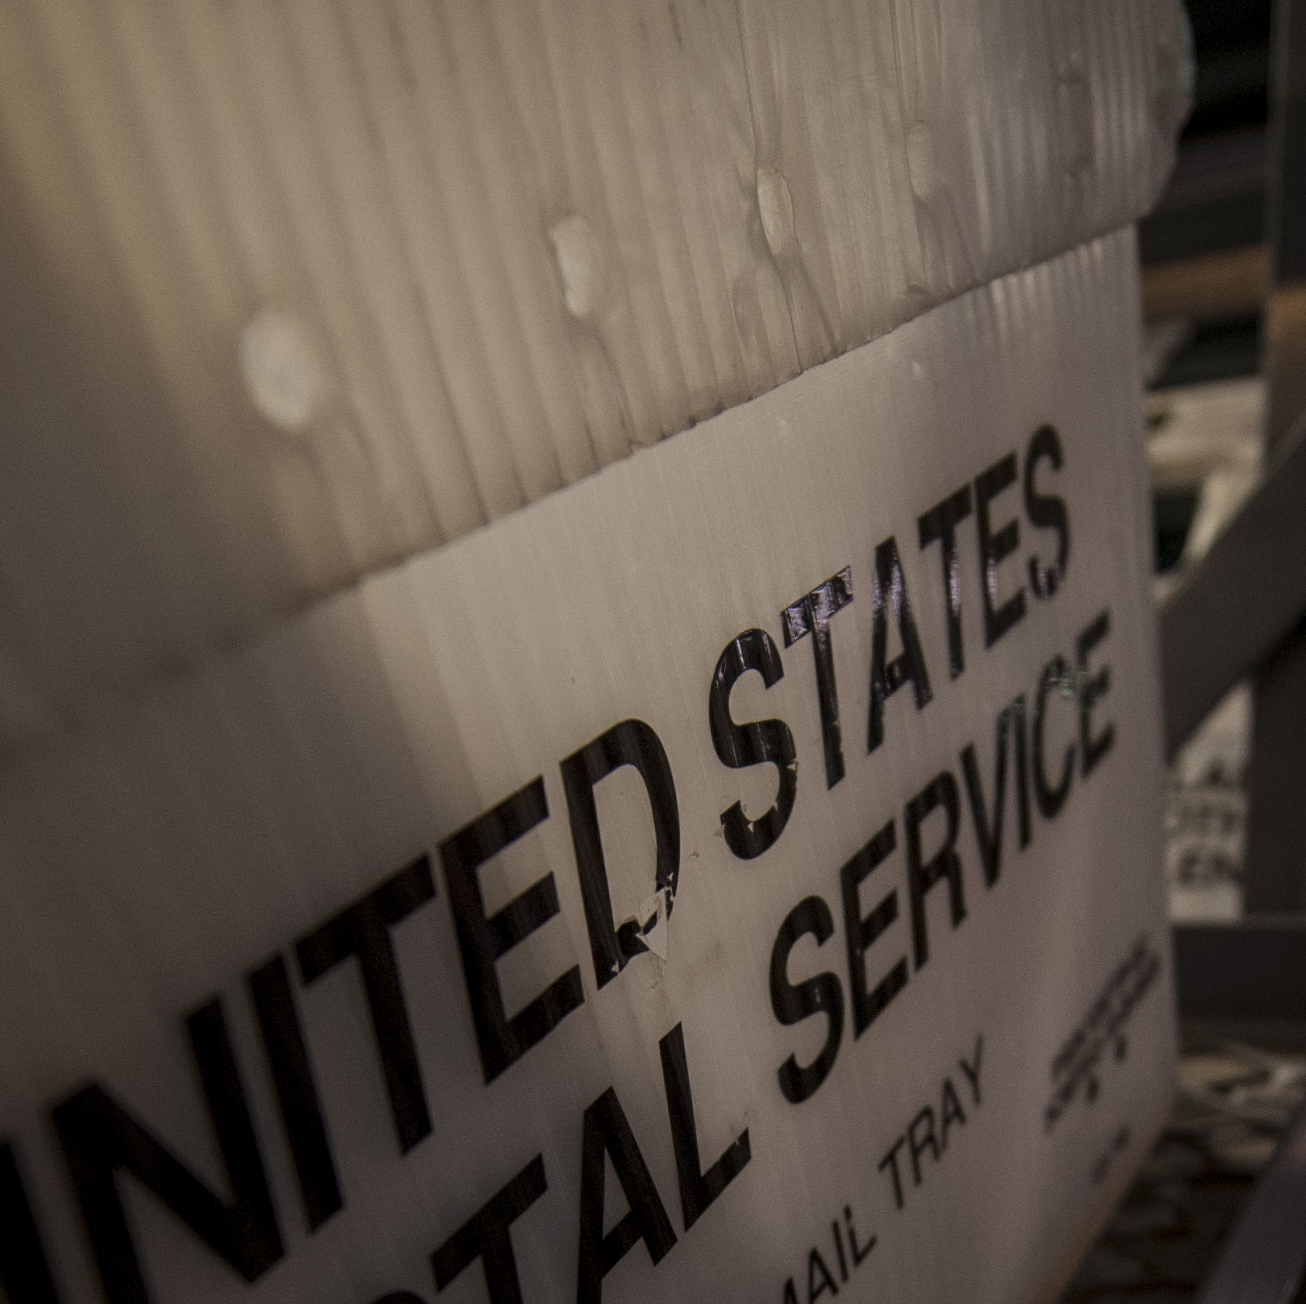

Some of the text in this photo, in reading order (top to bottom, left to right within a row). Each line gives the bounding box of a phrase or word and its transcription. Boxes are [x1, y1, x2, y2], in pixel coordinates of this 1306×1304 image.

[707, 424, 1069, 860] STATES
[767, 611, 1116, 1105] SERVICE
[877, 1034, 987, 1210] TRAY
